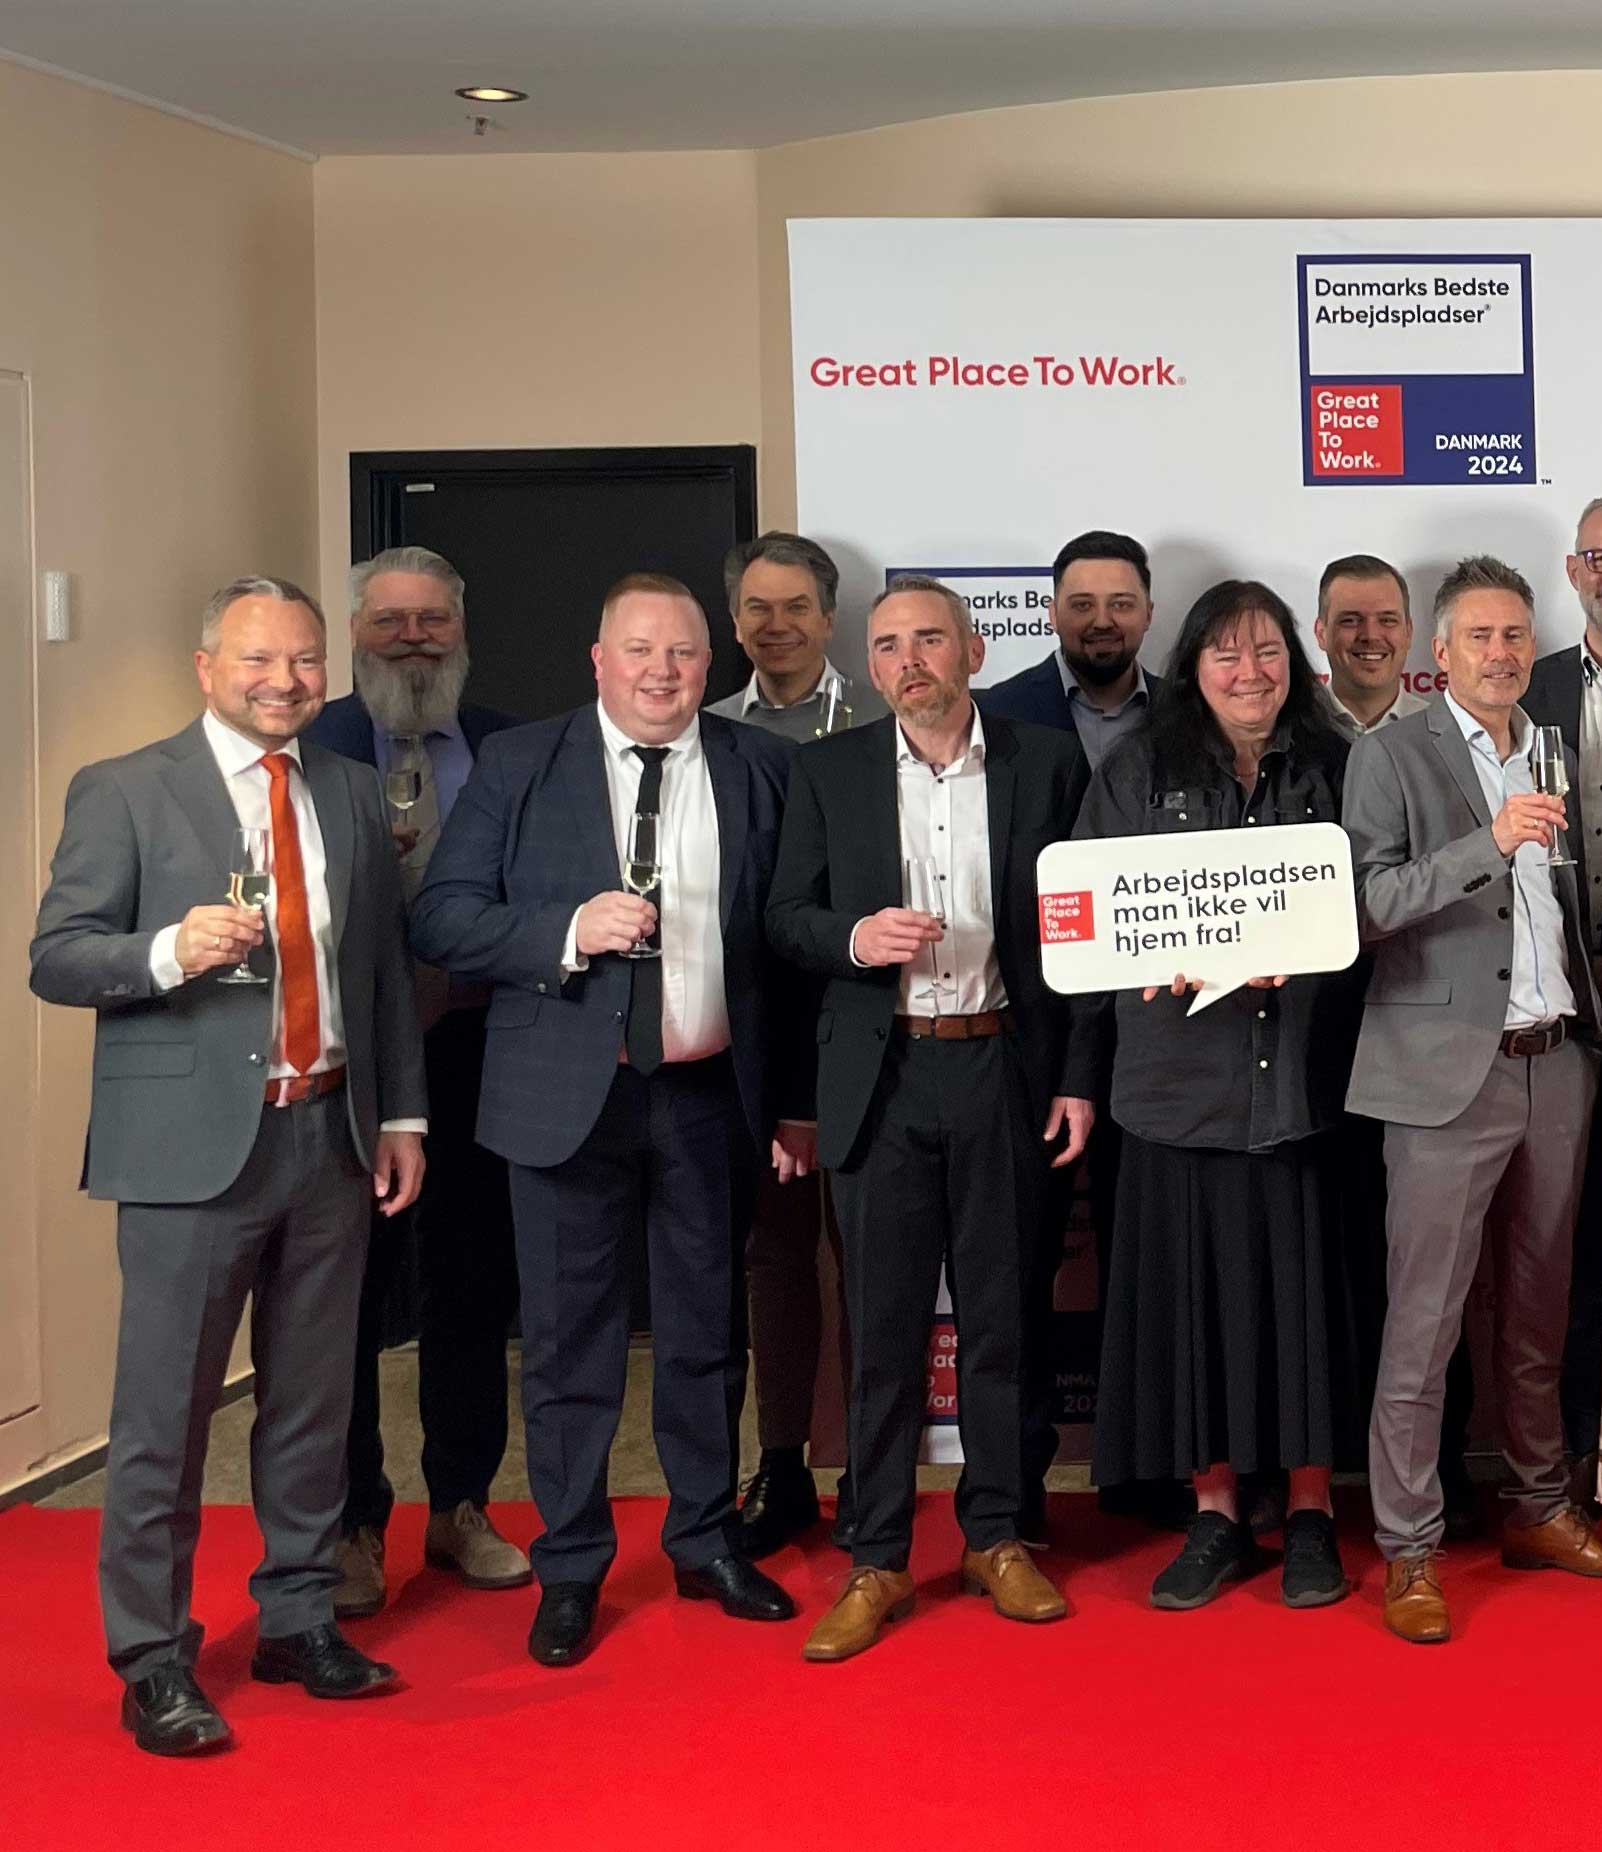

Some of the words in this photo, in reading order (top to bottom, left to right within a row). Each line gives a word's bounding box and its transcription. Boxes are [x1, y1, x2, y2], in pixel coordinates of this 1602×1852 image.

[1315, 276, 1428, 297] Danmarks
[1433, 277, 1510, 296] Bedste
[810, 357, 916, 387] Great
[928, 356, 1029, 386] Place
[1034, 356, 1075, 386] To
[1317, 391, 1380, 410] Great
[1319, 411, 1380, 429] Place
[1318, 431, 1343, 449] To
[1435, 433, 1523, 450] DANMARK
[1468, 455, 1524, 475] 2024
[963, 590, 1018, 609] arks
[1112, 861, 1337, 896] Arbejdspladsen
[1042, 895, 1081, 907] Great
[1113, 902, 1178, 924] man
[1187, 896, 1247, 918] ikke
[1256, 889, 1287, 912] vil
[1044, 907, 1081, 918] Place
[1044, 918, 1060, 930] To
[1115, 929, 1188, 957] hjem
[1196, 920, 1242, 945] fra!
